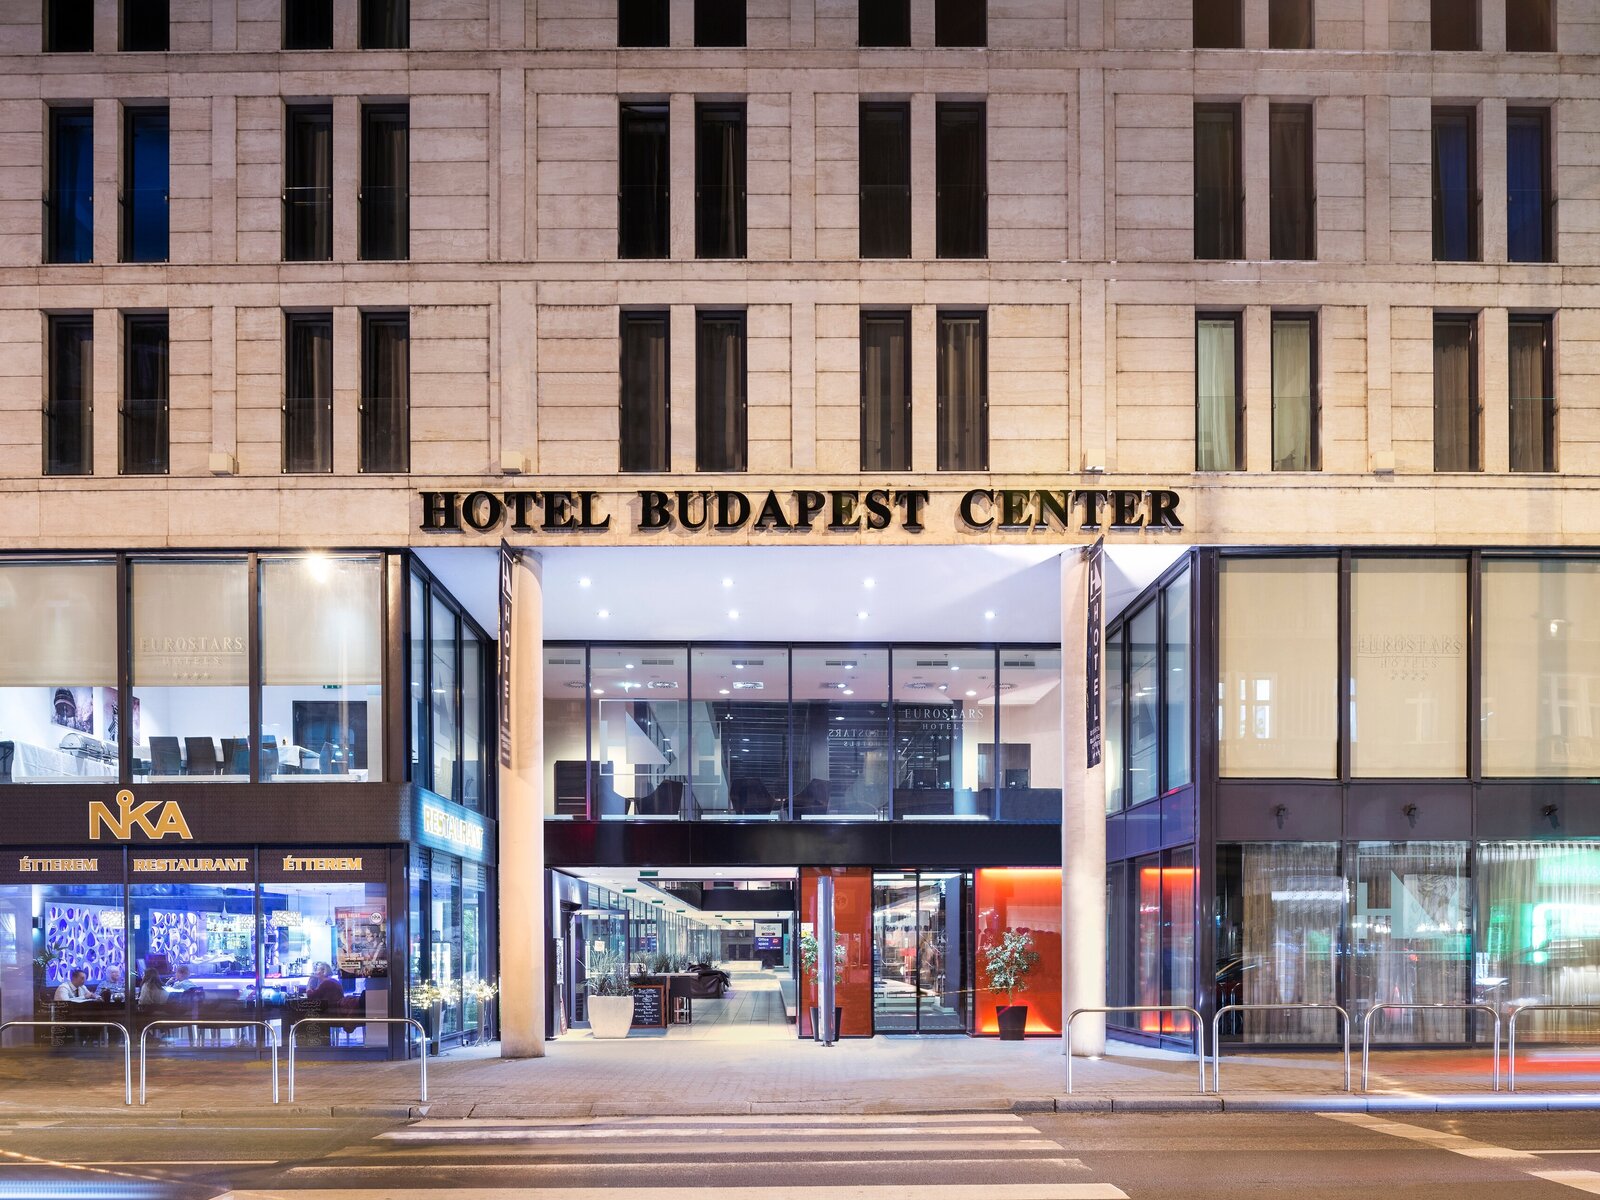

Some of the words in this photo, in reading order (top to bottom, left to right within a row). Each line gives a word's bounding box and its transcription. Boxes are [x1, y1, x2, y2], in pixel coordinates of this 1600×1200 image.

[419, 490, 611, 532] HOTEL
[637, 489, 929, 531] BUDAPEST
[960, 488, 1185, 531] CENTER
[140, 636, 244, 651] EUROSTARS
[905, 708, 984, 719] EUROSTARS
[423, 804, 484, 850] RESTAURANT
[19, 856, 98, 872] ÉTTEREM
[133, 858, 249, 872] RESTAURANT
[282, 855, 363, 871] ÉTTEREM
